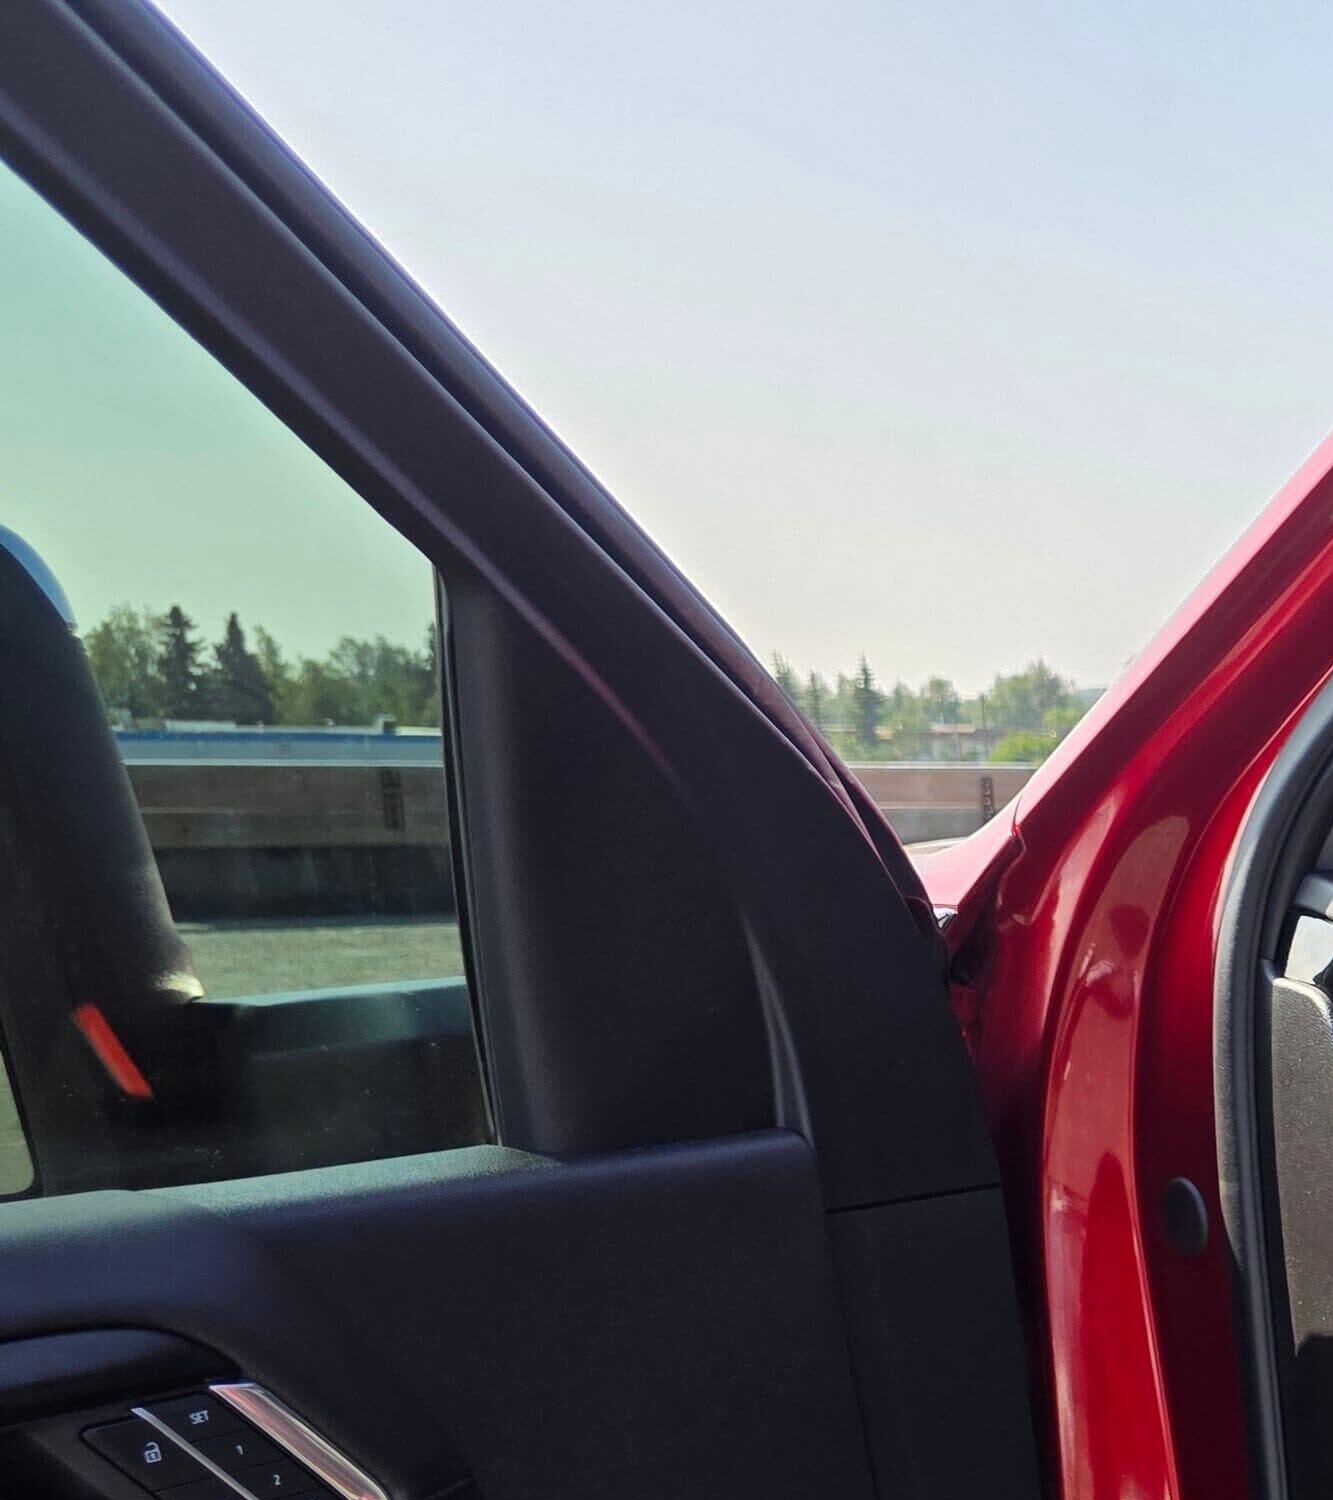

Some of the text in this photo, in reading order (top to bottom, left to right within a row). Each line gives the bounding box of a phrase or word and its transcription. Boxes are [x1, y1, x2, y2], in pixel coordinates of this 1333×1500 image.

[189, 1410, 209, 1424] SET
[236, 1444, 244, 1455] 1
[273, 1474, 281, 1485] 2
